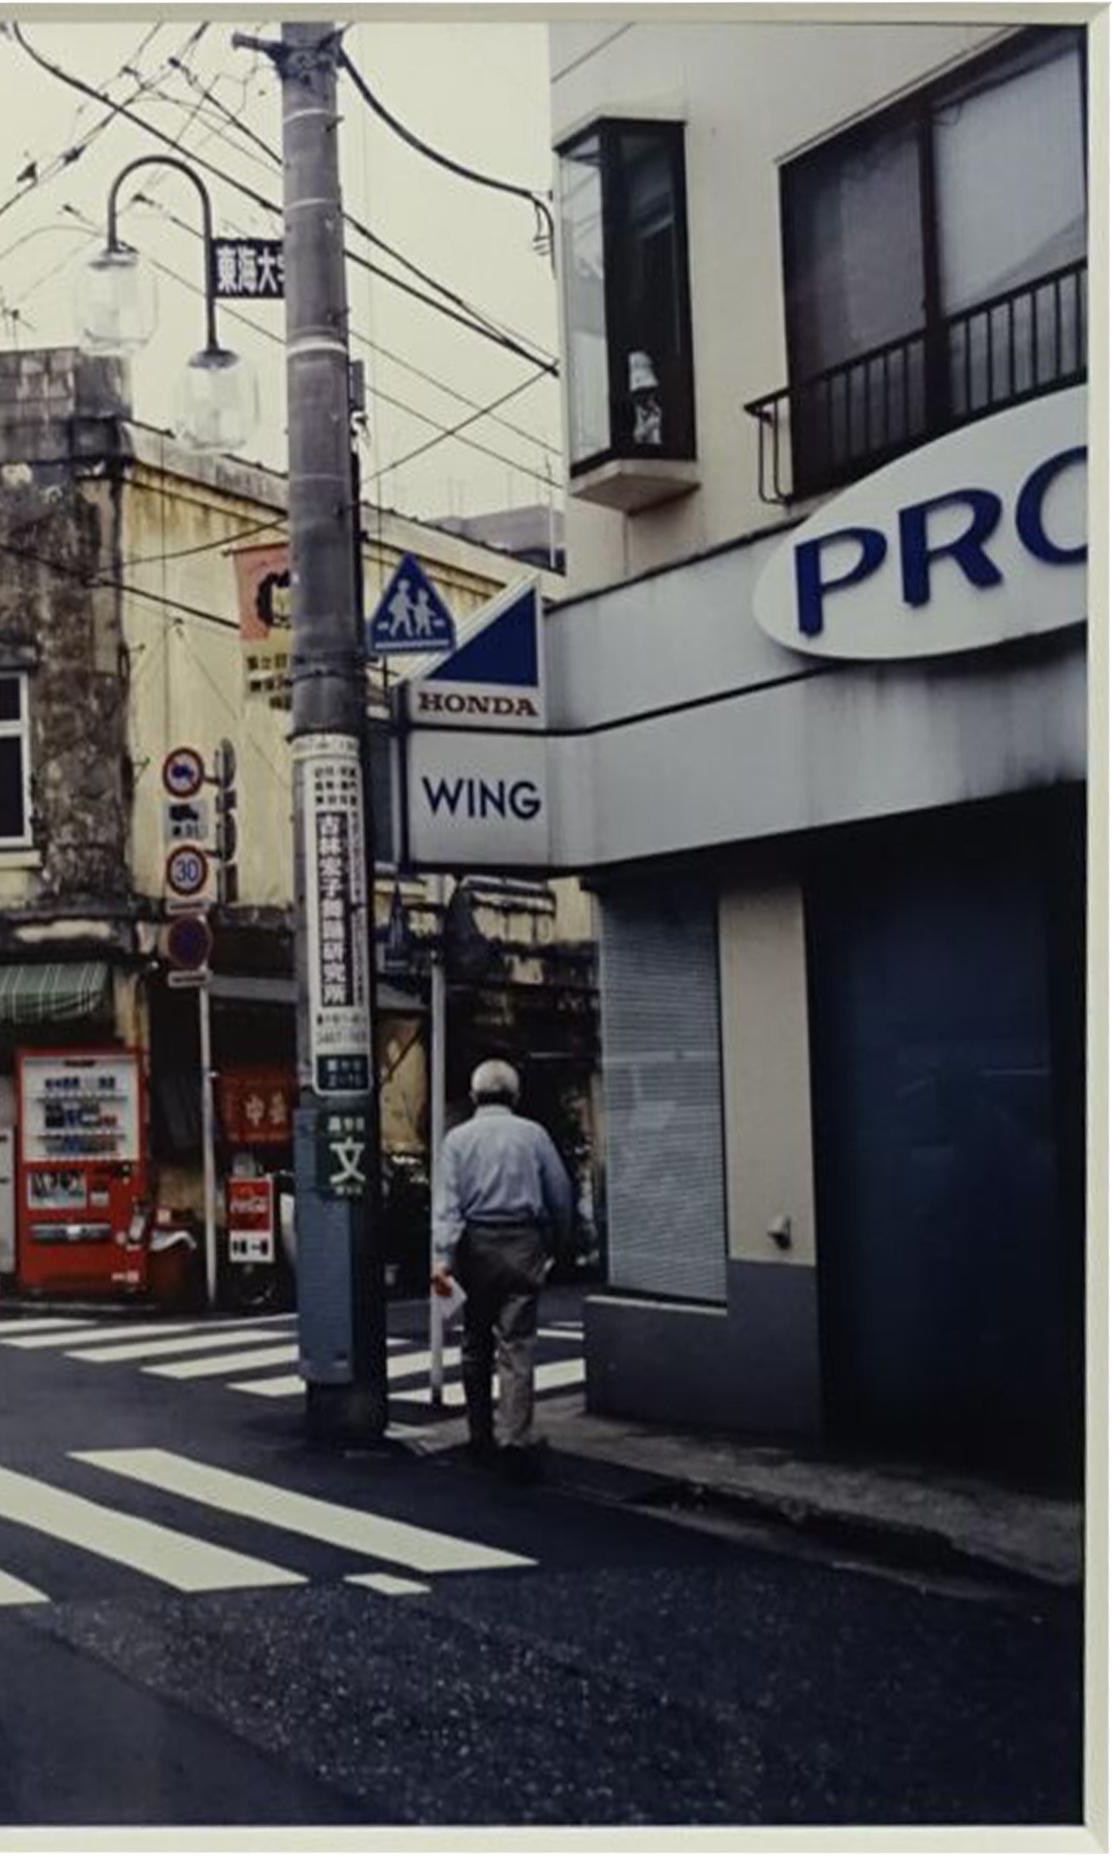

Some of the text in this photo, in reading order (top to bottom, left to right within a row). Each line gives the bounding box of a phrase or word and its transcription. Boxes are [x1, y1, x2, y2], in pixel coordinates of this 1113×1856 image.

[418, 691, 539, 717] HONDA
[421, 775, 541, 821] WING
[174, 858, 199, 882] 30
[329, 1137, 366, 1185] 文
